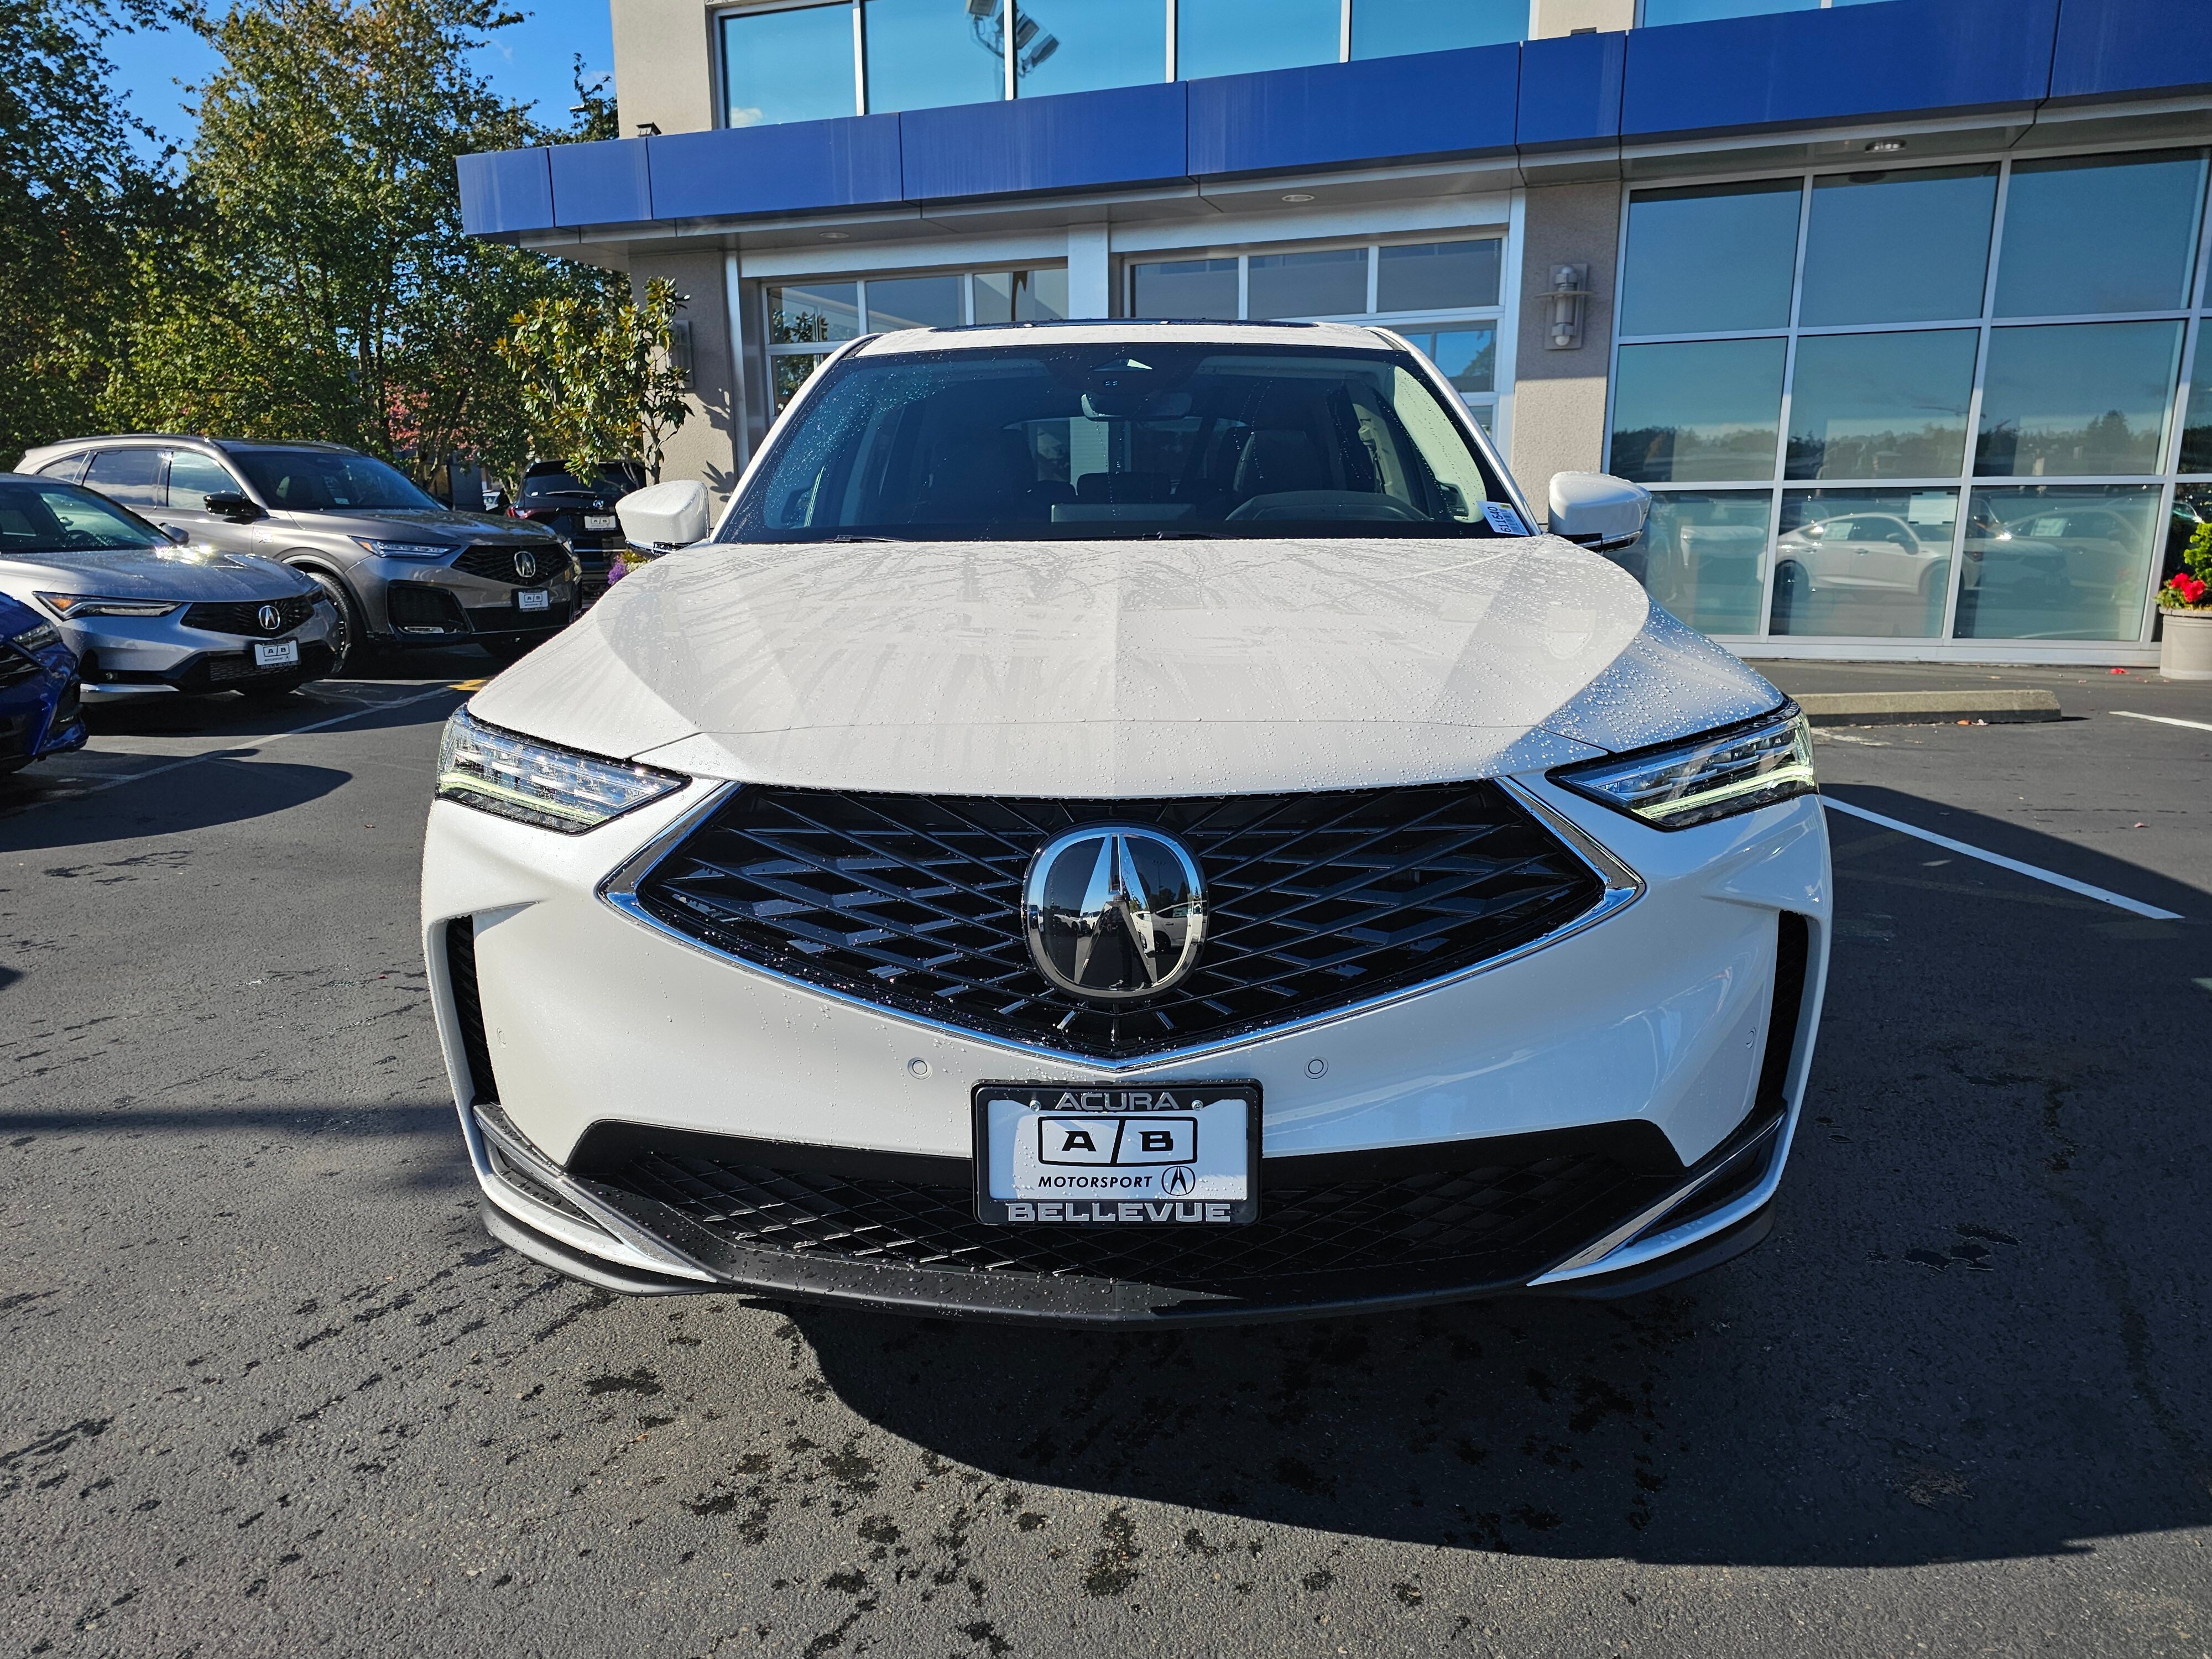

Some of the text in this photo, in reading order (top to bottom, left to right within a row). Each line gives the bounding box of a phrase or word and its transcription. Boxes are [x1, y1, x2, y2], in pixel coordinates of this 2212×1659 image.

[1487, 506, 1512, 533] 611540
[1055, 1092, 1180, 1111] ACURA
[1038, 1176, 1154, 1188] MOTORSPORT
[1005, 1203, 1231, 1223] BELLEVUE
